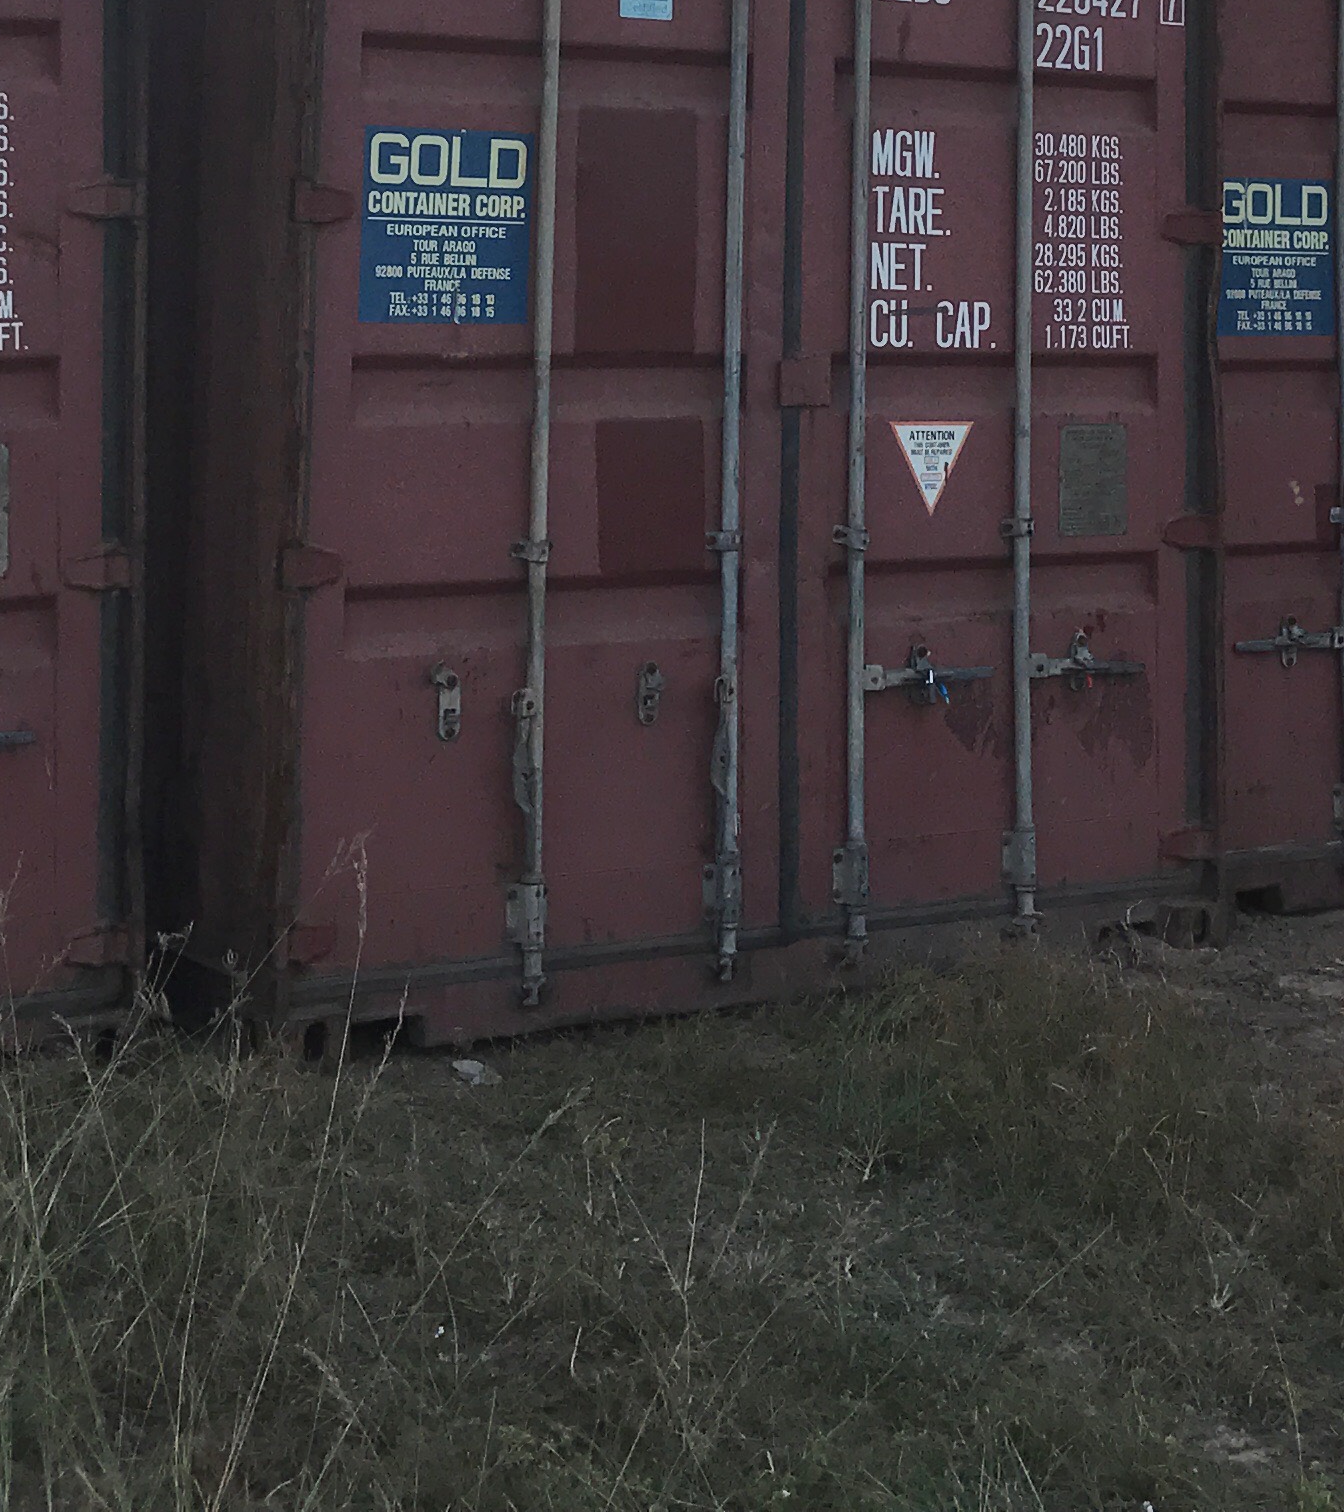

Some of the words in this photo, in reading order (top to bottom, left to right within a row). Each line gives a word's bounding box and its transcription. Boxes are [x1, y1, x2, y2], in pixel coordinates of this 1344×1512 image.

[1036, 23, 1103, 72] 22G1
[873, 129, 940, 178] MGW.
[1035, 133, 1086, 157] 30,480
[1092, 135, 1123, 159] KGS.
[370, 132, 528, 189] GOLD
[1035, 160, 1086, 184] 67,200
[1092, 162, 1123, 185] LBS.
[368, 191, 471, 216] CONTAINER
[475, 194, 526, 218] CORP.
[873, 185, 951, 236] TARE.
[1044, 188, 1086, 212] 2,185
[1092, 190, 1123, 213] KGS.
[1221, 181, 1328, 226] GOLD
[387, 224, 457, 237] EUROPEAN
[461, 227, 506, 239] OFFICE
[1044, 215, 1085, 238] 4,820
[1091, 216, 1122, 239] LBS.
[413, 240, 438, 252] TOUR
[443, 240, 475, 252] ARAGO
[1293, 231, 1329, 250] CORP.
[411, 253, 417, 264] 5
[421, 254, 439, 265] RUE
[872, 243, 933, 291] NET.
[1035, 243, 1085, 267] 28,295
[1092, 244, 1123, 267] KGS.
[1233, 255, 1283, 266] EUROPEAN
[1284, 256, 1316, 266] OFFICE
[408, 266, 466, 279] PUTEAUX/LA
[1034, 270, 1085, 294] 62,380
[1092, 271, 1123, 294] LBS.
[424, 280, 460, 291] FRANCE
[432, 293, 437, 304] 1
[432, 306, 436, 317] 1
[870, 300, 914, 348] CU.
[936, 301, 995, 348] CAP.
[1045, 325, 1086, 349] 1,173
[909, 431, 954, 440] ATTENTION
